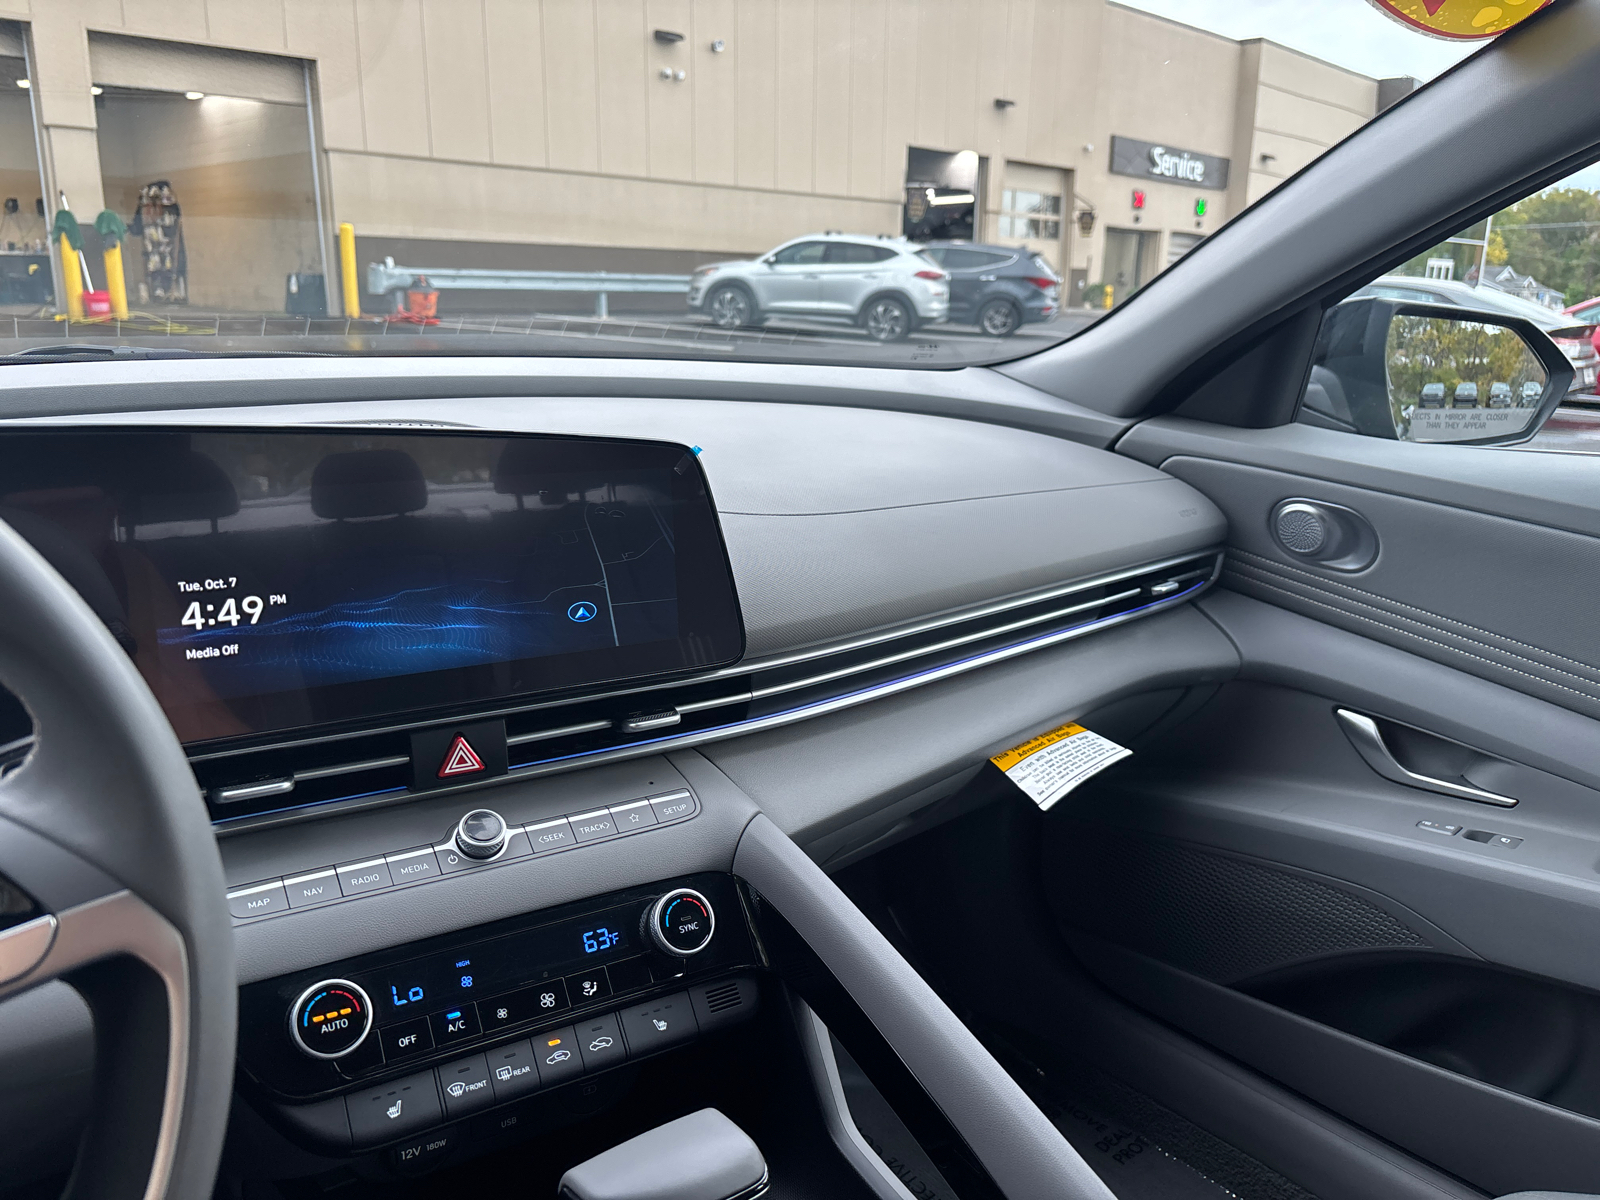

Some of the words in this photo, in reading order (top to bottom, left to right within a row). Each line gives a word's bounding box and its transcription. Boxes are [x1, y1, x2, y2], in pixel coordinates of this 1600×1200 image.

[1152, 147, 1204, 182] Service
[204, 578, 228, 590] Oct.
[228, 578, 237, 588] 7
[181, 595, 264, 630] 4:49
[269, 594, 286, 605] PM
[186, 646, 220, 660] Media
[222, 644, 239, 656] Off
[1018, 741, 1046, 757] Advanced
[993, 752, 1009, 762] This
[1020, 761, 1034, 772] Even
[1046, 742, 1069, 755] Advanced
[663, 804, 688, 816] SETUP
[400, 862, 430, 876] MEDIA
[350, 872, 380, 886] RADIO
[303, 885, 324, 897] NAV
[246, 896, 271, 909] MAP
[678, 922, 699, 934] SYNC
[455, 960, 470, 968] HIGH
[320, 1018, 349, 1034] AUTO
[448, 1019, 466, 1034] A/C
[398, 1034, 418, 1048] OFF
[513, 1066, 531, 1078] REAR
[465, 1080, 488, 1094] FRONT
[500, 1116, 518, 1128] USB
[400, 1146, 422, 1161] 12V
[426, 1138, 448, 1152] 180W
